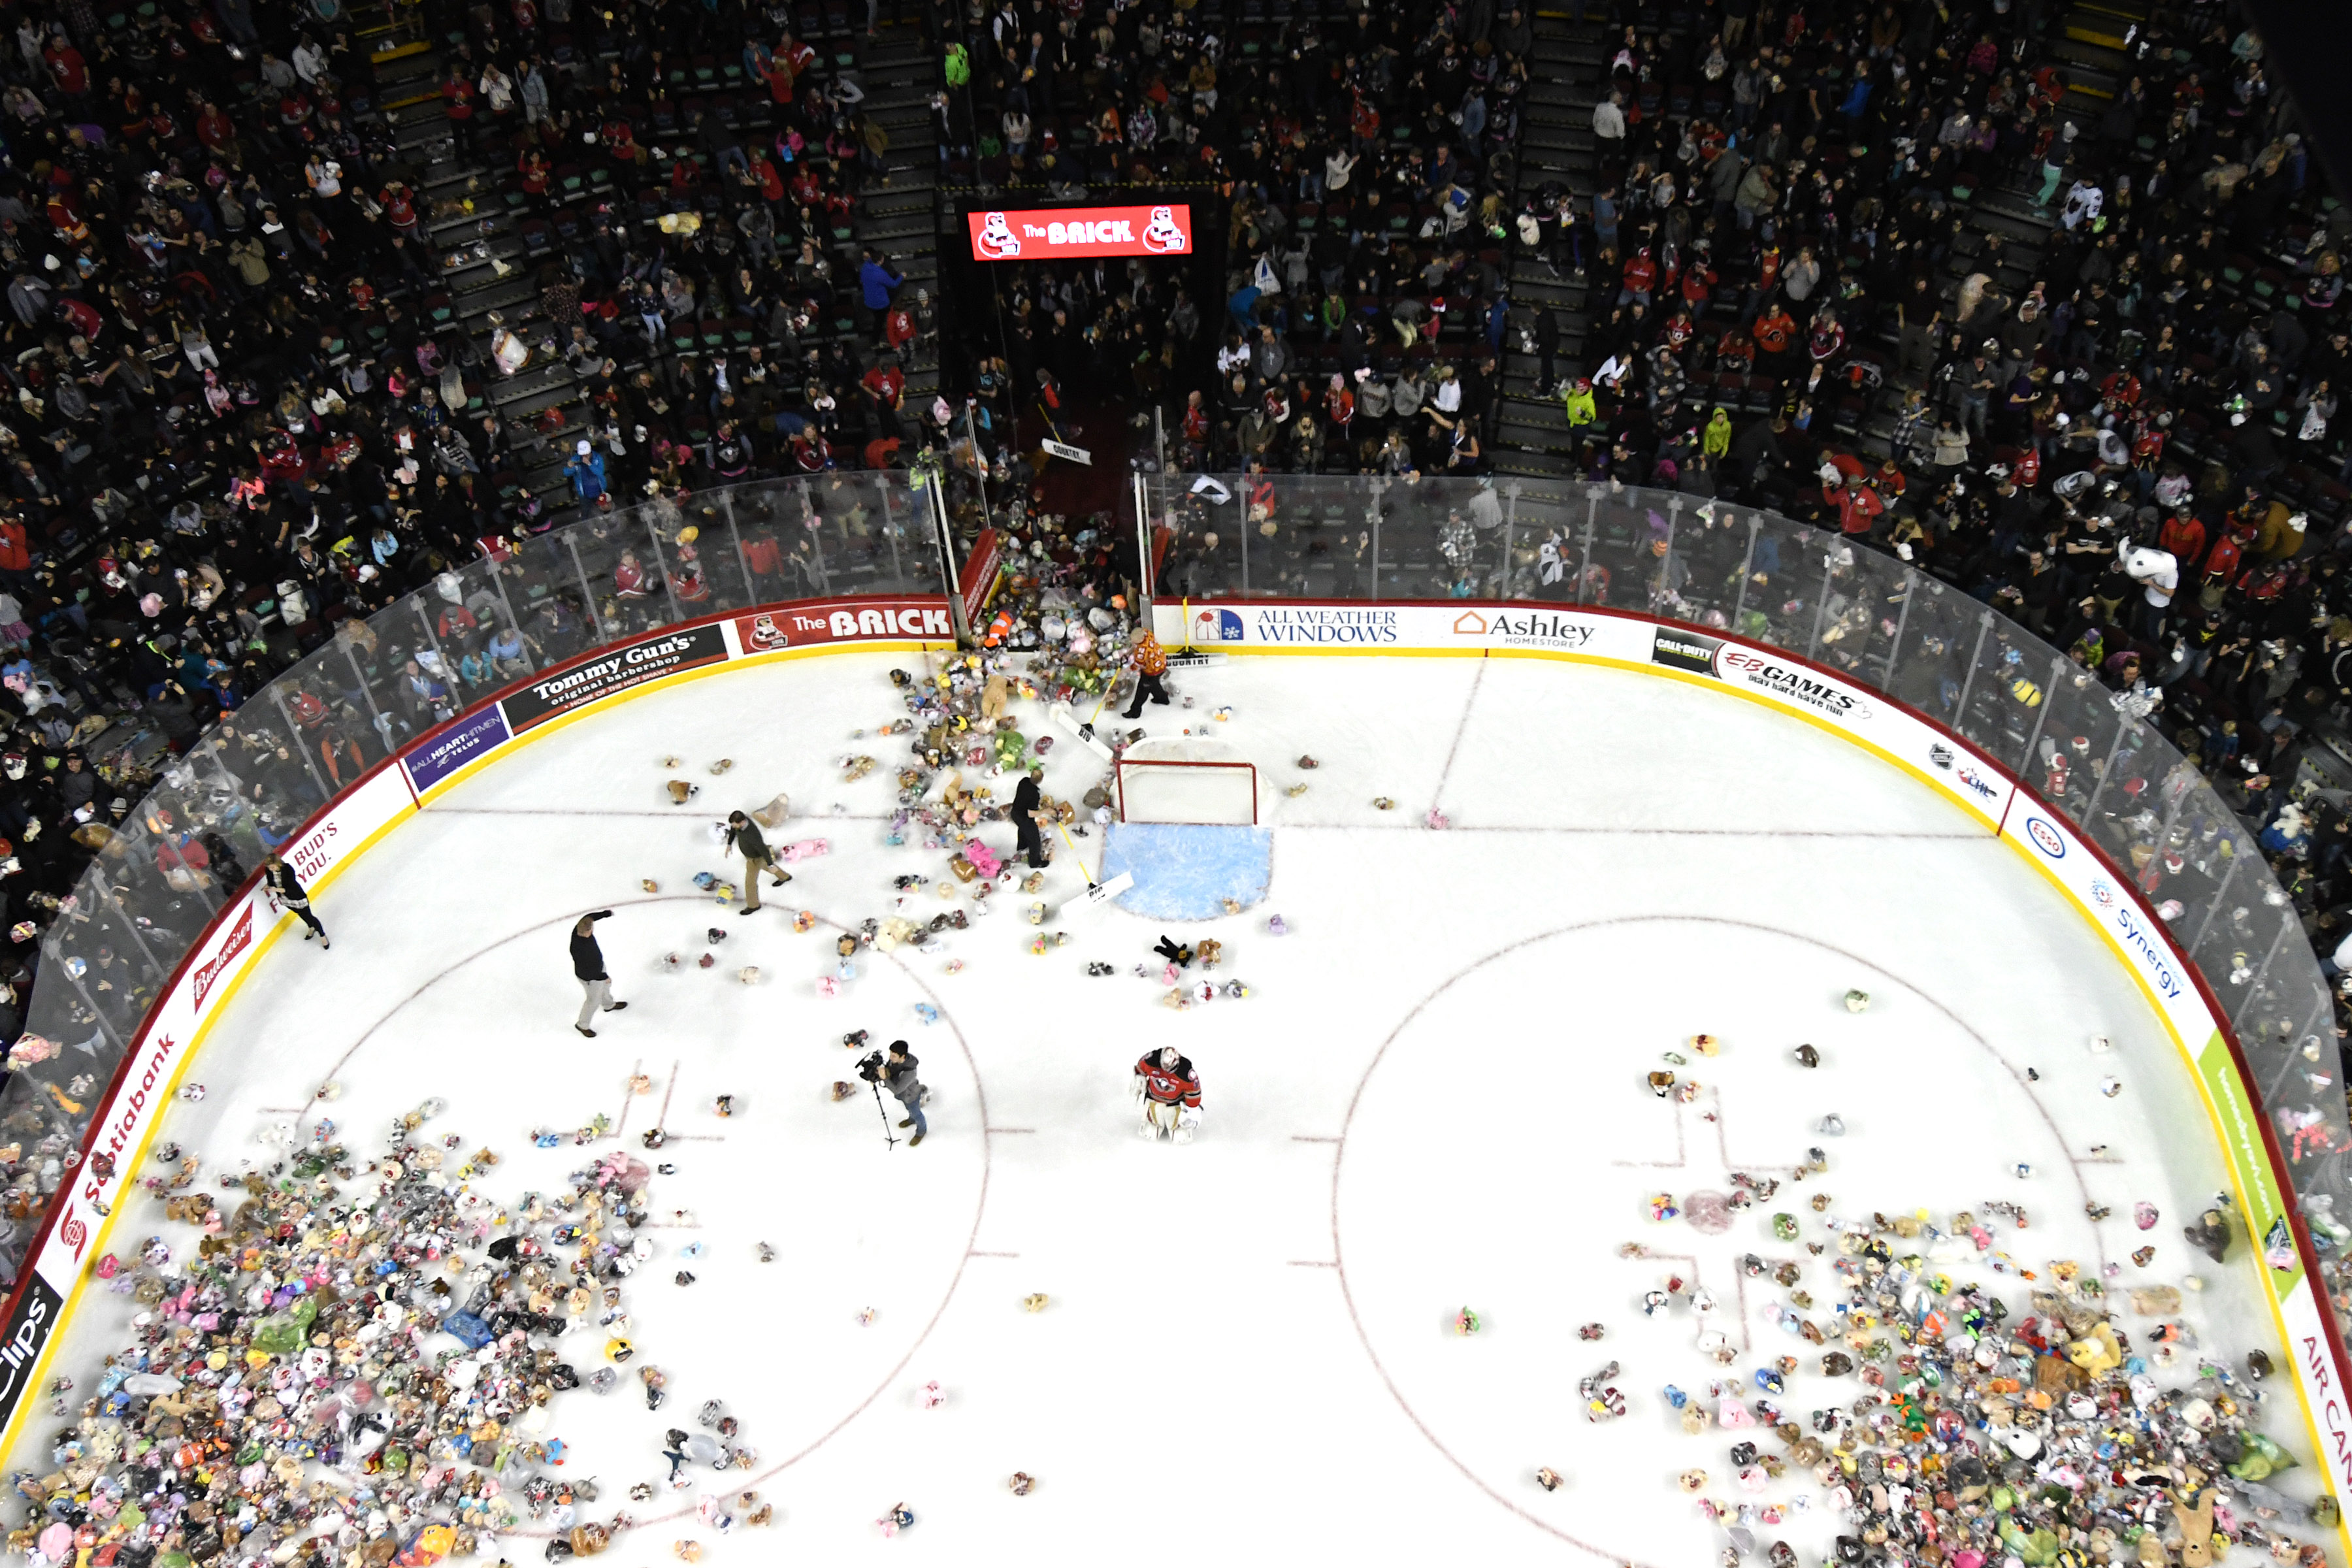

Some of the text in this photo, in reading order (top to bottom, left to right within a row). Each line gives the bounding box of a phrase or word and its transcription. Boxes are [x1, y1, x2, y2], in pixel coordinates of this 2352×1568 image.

[1022, 224, 1045, 237] The
[792, 609, 951, 636] The BRICK
[1258, 610, 1396, 624] ALL WEATHER
[1258, 625, 1397, 642] WINDOWS
[1490, 615, 1595, 645] Ashley
[1505, 637, 1575, 648] HOMESTORE
[1656, 638, 1682, 653] CALL
[534, 657, 621, 700] Tommy
[551, 655, 680, 706] original barbershop
[570, 694, 594, 708] HOME
[608, 683, 622, 693] THE
[623, 676, 641, 687] HOT
[642, 668, 666, 681] SHAVE
[1723, 652, 1765, 672] EB
[1762, 666, 1855, 710] GAMES
[1748, 673, 1843, 717] play hard have fun
[451, 737, 480, 756] TELUS
[294, 822, 337, 866] BUD'S
[191, 917, 253, 1000] Budweiser
[2117, 909, 2180, 998] Synergy
[2303, 1337, 2352, 1494] AIR CAN
